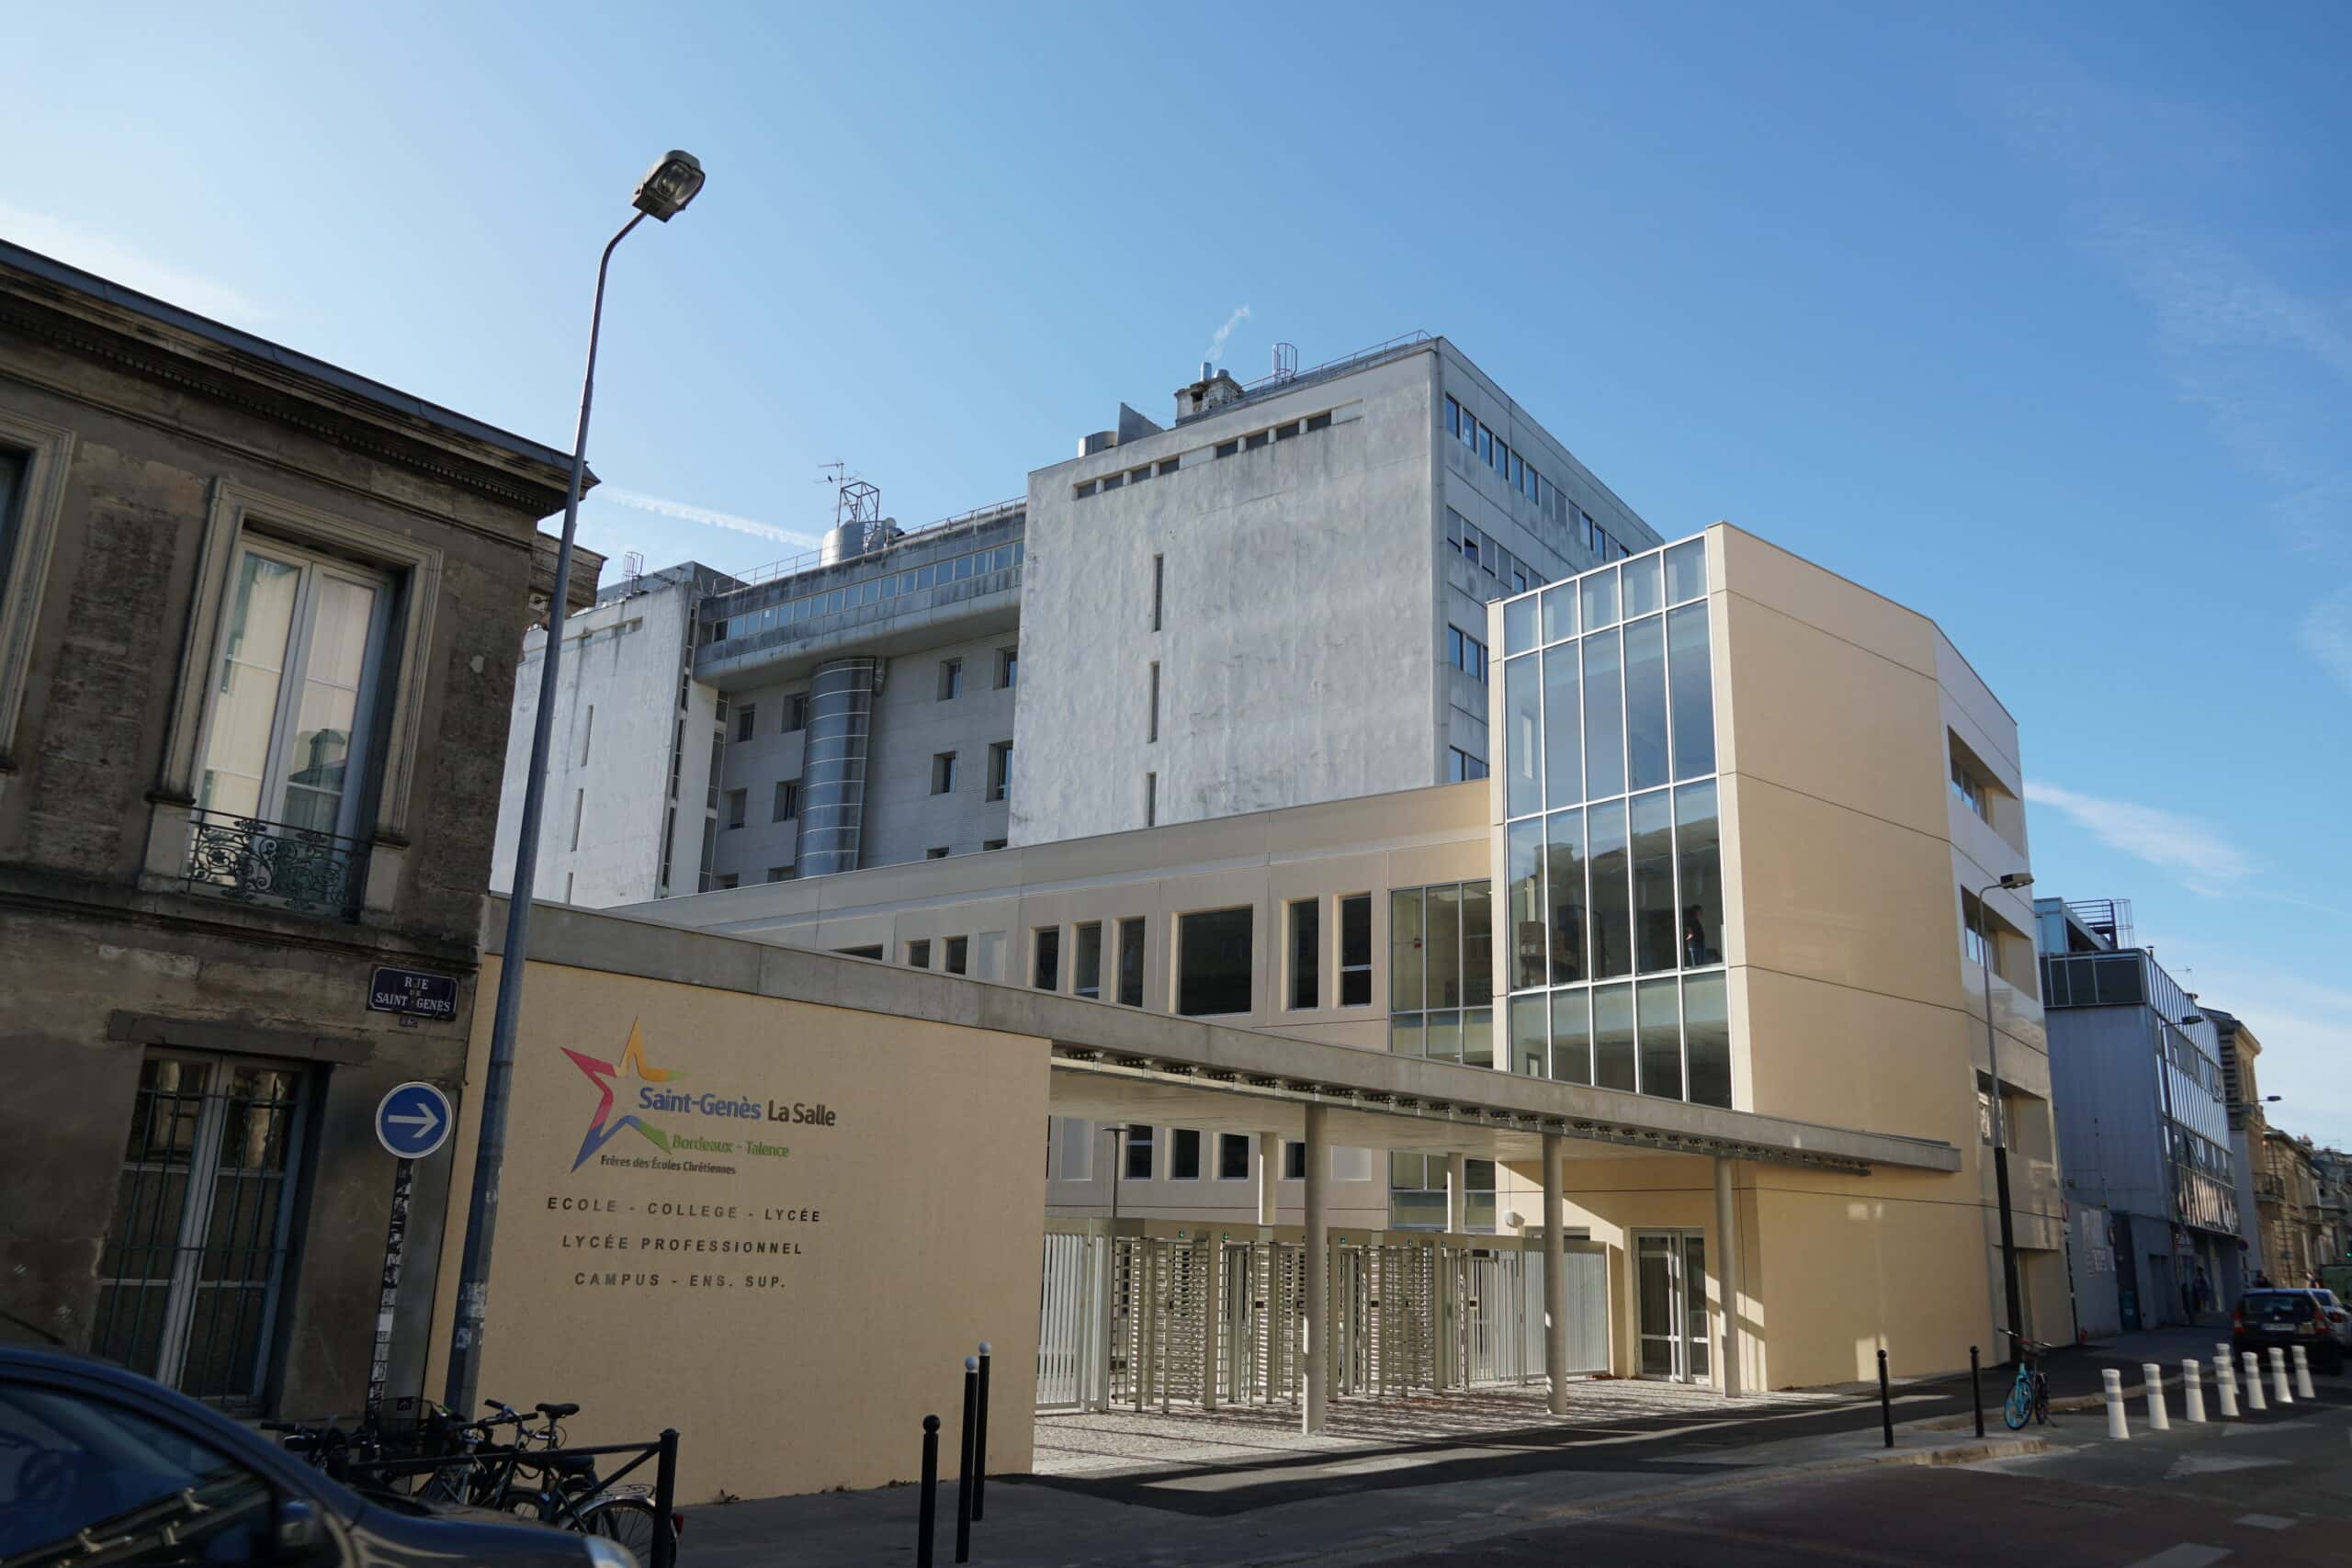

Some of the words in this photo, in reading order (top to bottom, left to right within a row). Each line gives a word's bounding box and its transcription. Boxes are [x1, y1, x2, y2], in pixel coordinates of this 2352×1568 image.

[375, 992, 408, 1007] SAINT
[639, 1087, 762, 1120] Saint-Genès
[767, 1100, 789, 1122] La
[792, 1102, 836, 1126] Salle
[672, 1134, 735, 1153] Bordeaux
[745, 1140, 790, 1157] Talence
[600, 1154, 631, 1168] Frères
[632, 1157, 649, 1169] des
[650, 1156, 681, 1171] Écoles
[683, 1160, 736, 1175] Chrétiennes
[547, 1197, 617, 1213] ECOLE
[647, 1201, 738, 1219] COLLEGE
[764, 1207, 821, 1223] LYCÉE
[561, 1234, 629, 1250] LYCÉE
[640, 1237, 803, 1255] PROFESSIONNEL
[574, 1271, 661, 1287] CAMPUS
[689, 1274, 735, 1287] ENS.
[744, 1275, 786, 1289] SUP.
